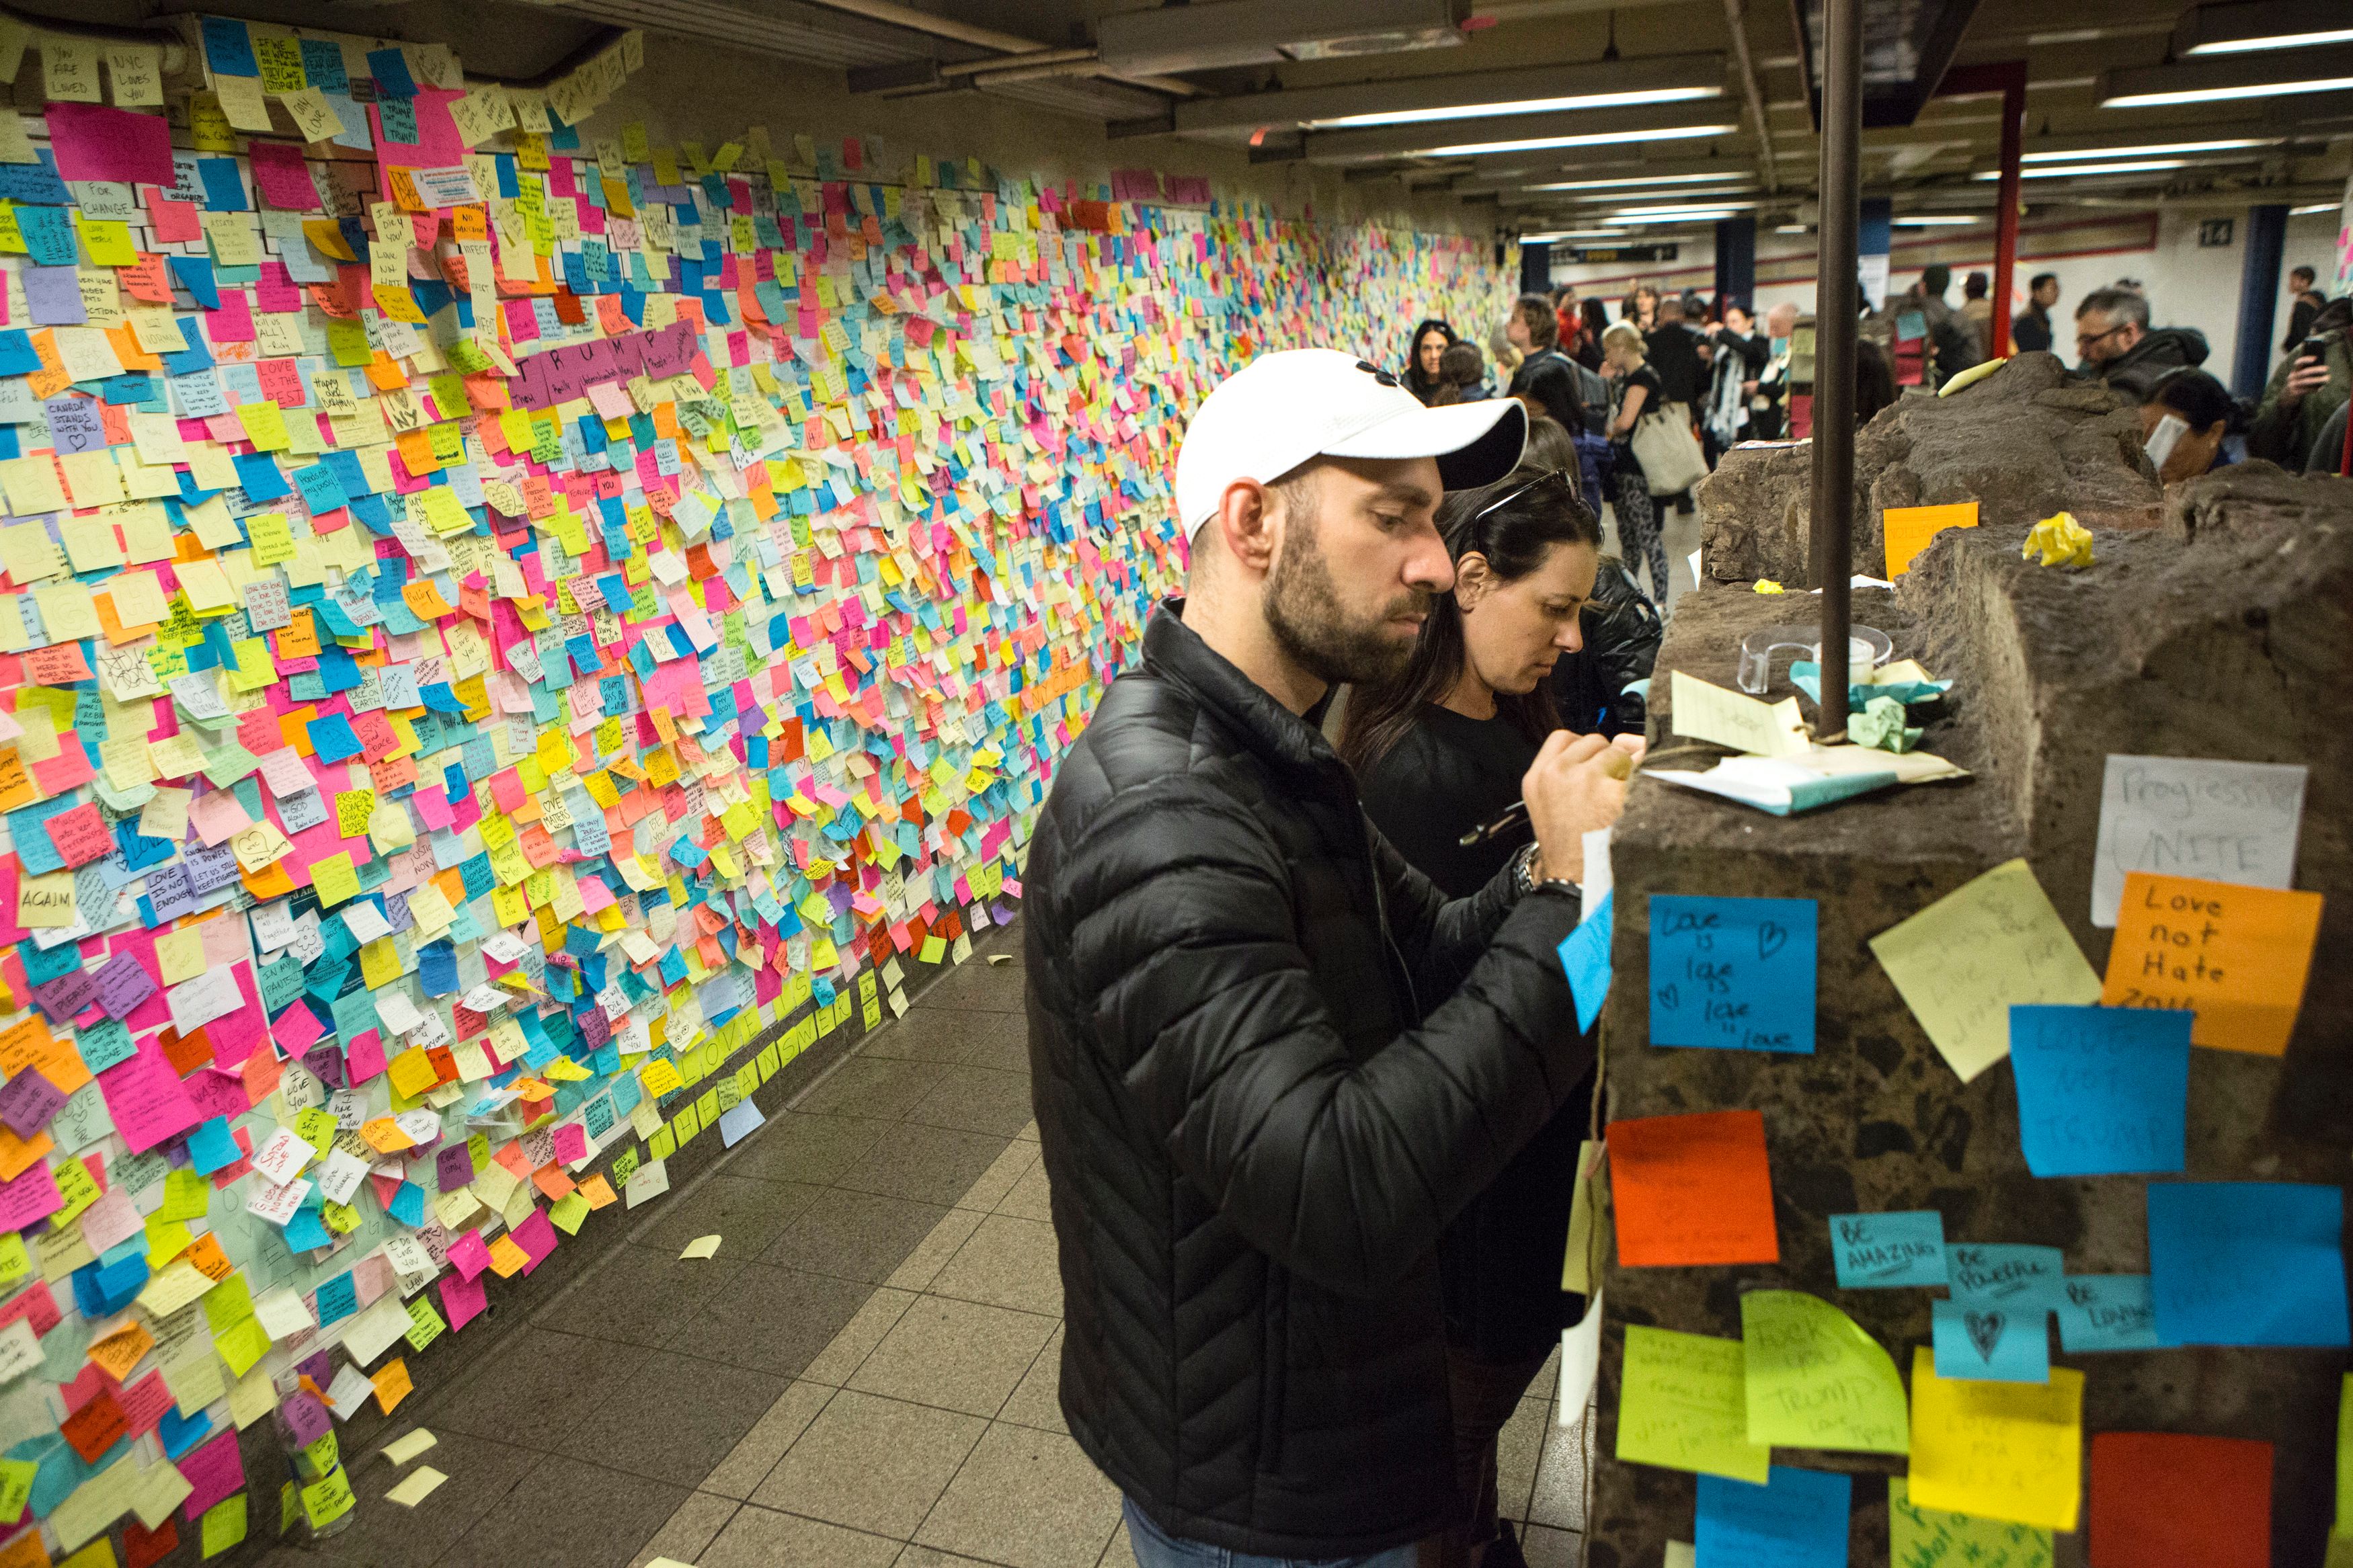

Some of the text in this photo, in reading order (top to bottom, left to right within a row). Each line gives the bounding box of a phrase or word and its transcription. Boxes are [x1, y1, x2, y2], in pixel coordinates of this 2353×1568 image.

[115, 56, 144, 69] NYC
[50, 81, 87, 94] LOVED
[83, 202, 132, 215] CHANGE
[260, 361, 292, 374] LOVE
[263, 374, 298, 388] IS THE
[49, 401, 86, 413] CANADA
[54, 413, 91, 423] STANDS
[422, 687, 448, 702] STAY
[148, 868, 177, 889] LOVE
[167, 876, 189, 889] NOT
[155, 889, 196, 911] ENOUGH
[2145, 885, 2224, 917] Love
[2144, 955, 2225, 984] Hate
[679, 1012, 757, 1083] LOVE
[287, 1081, 309, 1096] LOVE
